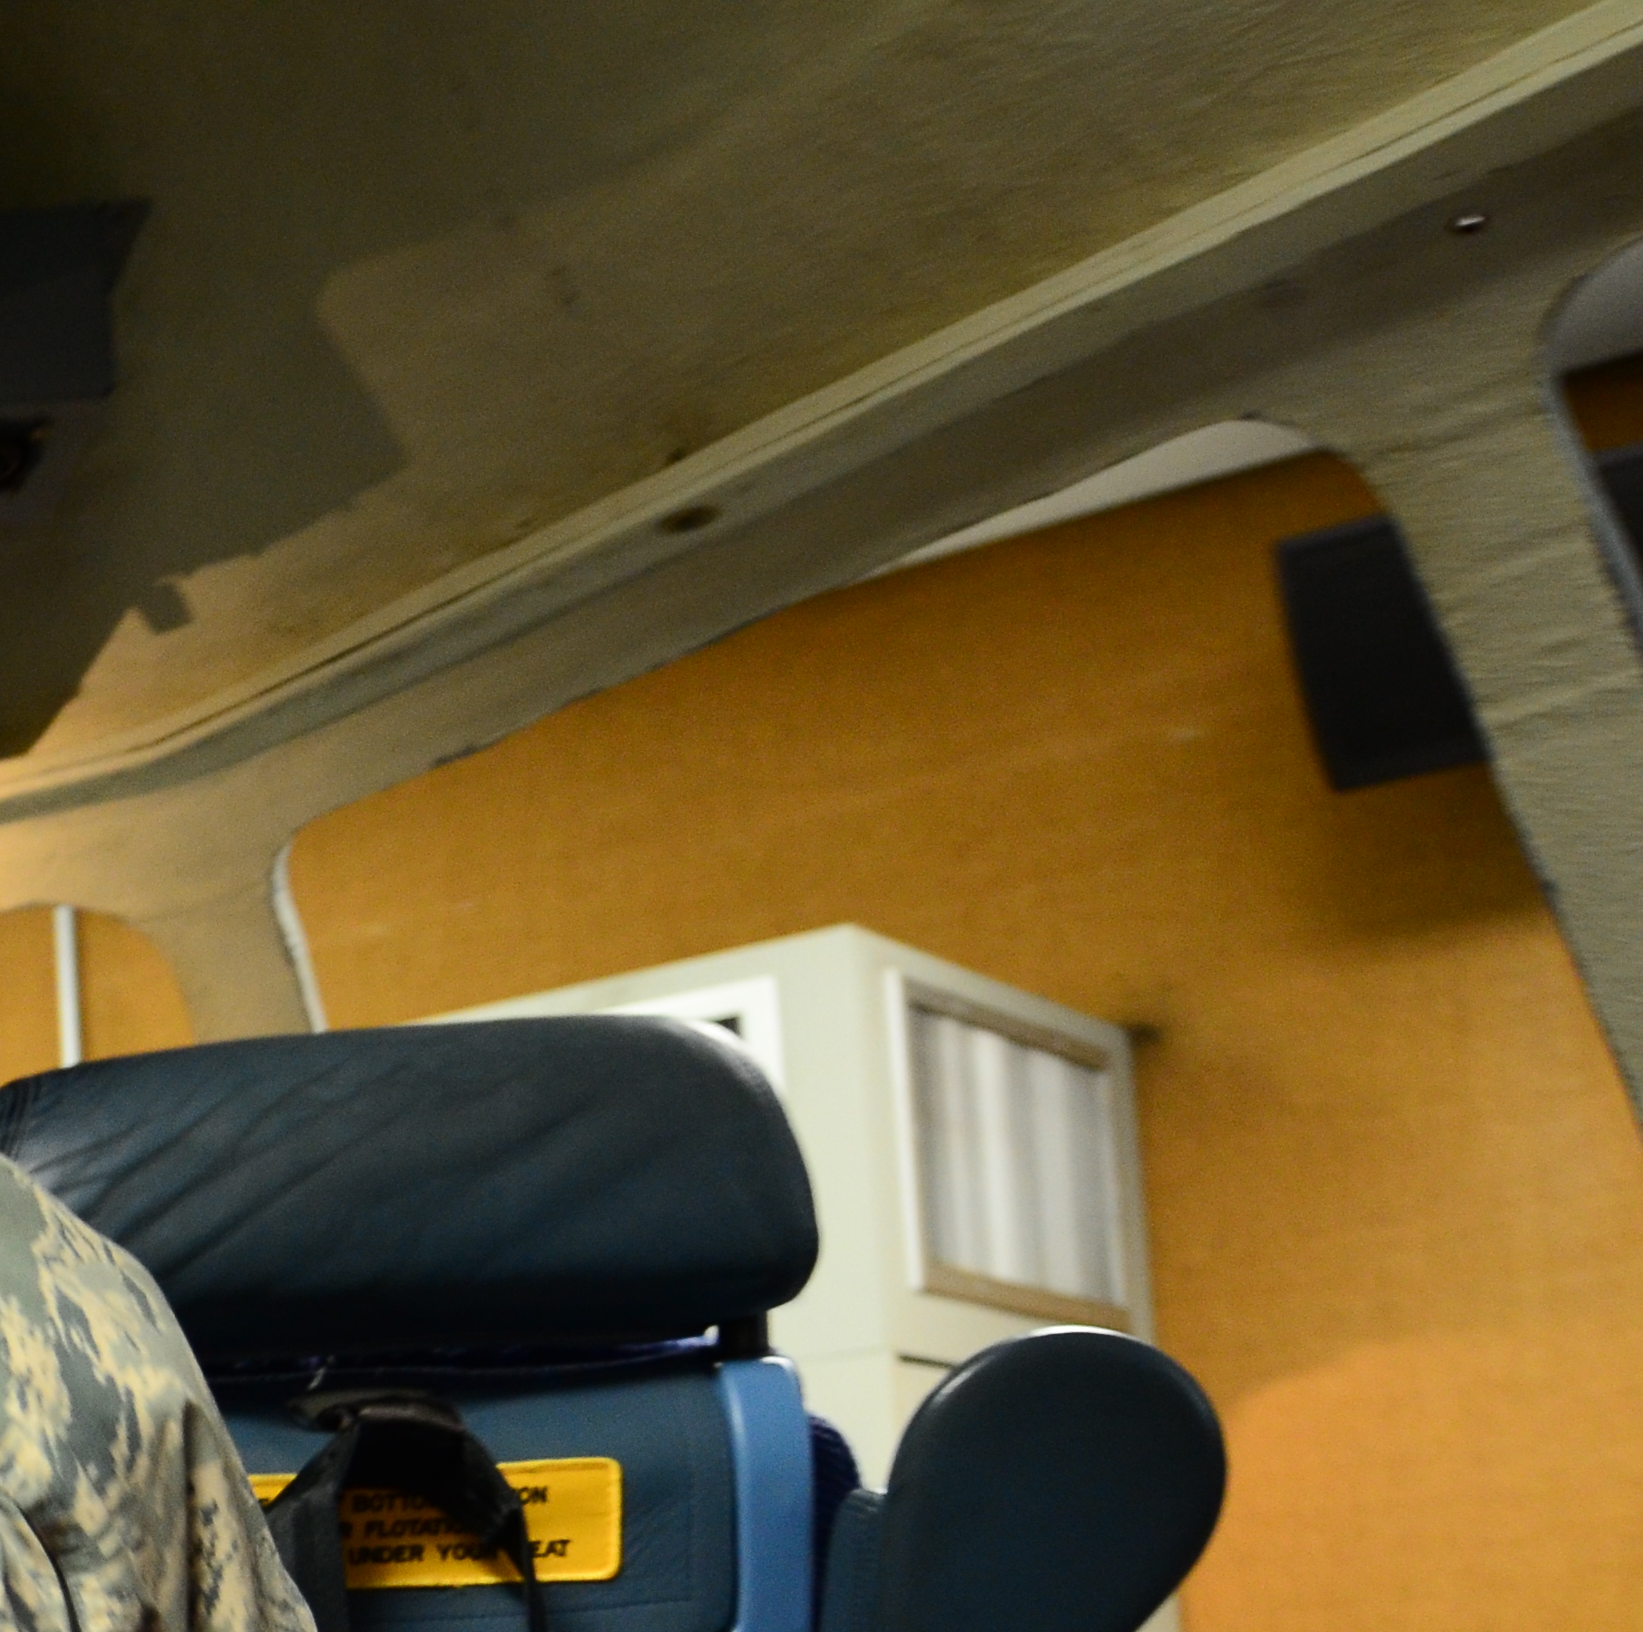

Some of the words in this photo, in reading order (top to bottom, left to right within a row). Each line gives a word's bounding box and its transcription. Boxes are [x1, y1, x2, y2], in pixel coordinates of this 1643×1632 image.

[352, 1489, 433, 1513] BOTTO
[350, 1544, 423, 1564] UNDER
[529, 1539, 571, 1557] EAT
